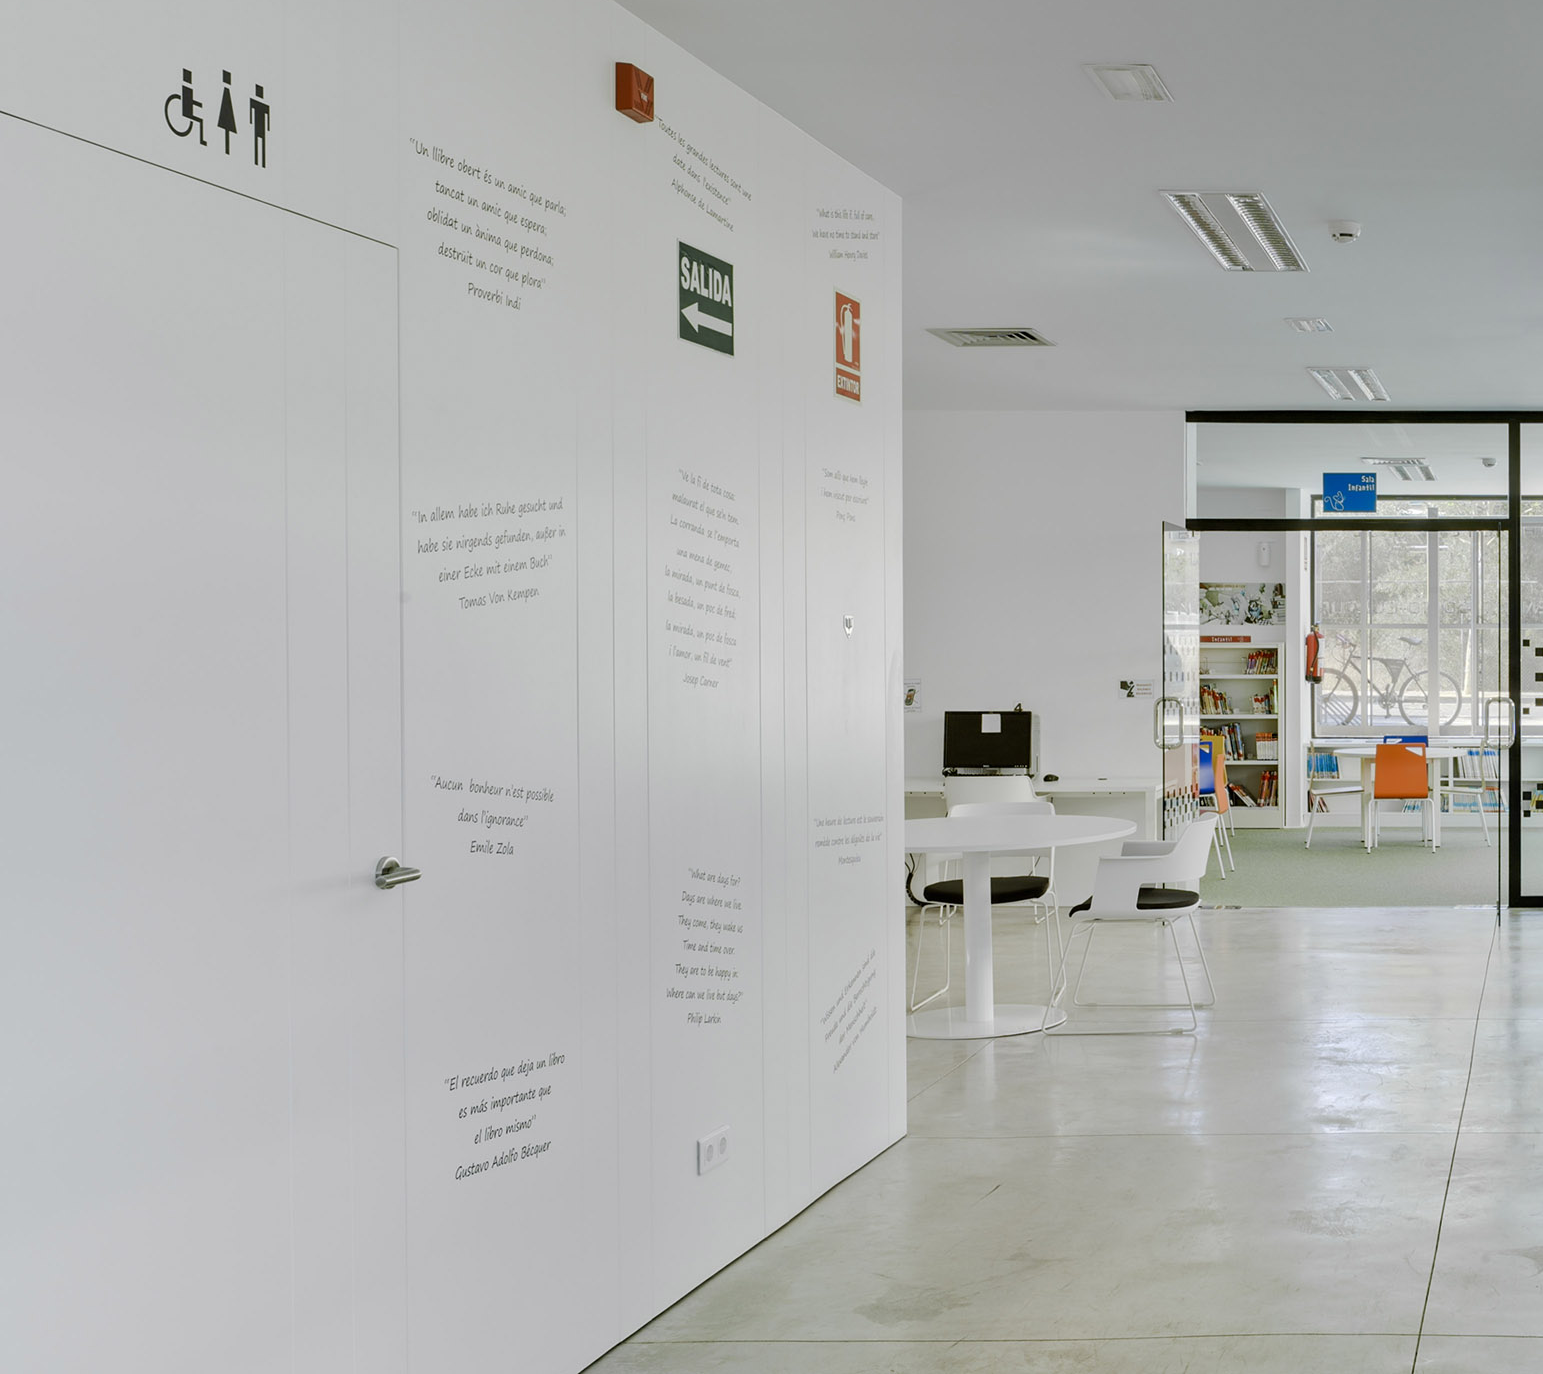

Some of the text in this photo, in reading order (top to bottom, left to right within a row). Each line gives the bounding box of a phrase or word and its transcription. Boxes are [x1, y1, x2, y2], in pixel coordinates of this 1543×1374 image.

[433, 147, 454, 168] llibre
[458, 159, 481, 179] obert
[484, 170, 492, 184] és
[495, 178, 505, 190] un
[508, 183, 527, 199] amic
[529, 191, 542, 206] que
[435, 180, 464, 202] tancat
[468, 195, 479, 208] un
[482, 200, 501, 217] amic
[504, 210, 518, 224] que
[427, 207, 458, 231] oblidat
[461, 222, 472, 235] un
[476, 224, 502, 246] ànima
[504, 239, 518, 254] que
[476, 258, 487, 270] un
[490, 263, 503, 275] cor
[505, 269, 519, 282] que
[681, 257, 732, 307] SALIDA
[468, 282, 521, 310] Proverbi Indi
[430, 507, 454, 522] allem
[458, 504, 478, 518] habe
[481, 503, 493, 517] ich
[496, 502, 515, 515] Ruhe
[518, 499, 546, 517] gesucht
[549, 497, 563, 510] und
[418, 525, 566, 554] habe sie nirgends gefunden, außer in
[439, 569, 461, 583] einer
[464, 564, 483, 579] Ecke
[487, 561, 501, 576] mit
[504, 559, 528, 573] einem
[459, 587, 540, 610] Tomas Von Kempen
[1013, 703, 1023, 712] 4
[469, 778, 503, 796] bonheur
[506, 785, 524, 799] n'est
[526, 788, 554, 803] possible
[458, 808, 478, 823] dans
[470, 840, 514, 855] Emile Zola
[707, 873, 716, 883] are
[717, 873, 729, 888] days
[682, 891, 695, 906] Days
[697, 896, 705, 905] are
[707, 896, 722, 907] where
[724, 900, 732, 908] we
[678, 915, 691, 930] They
[710, 919, 721, 933] they
[723, 922, 736, 933] wake
[683, 939, 696, 951] Time
[698, 942, 708, 952] and
[710, 942, 722, 954] time
[675, 963, 731, 981] They are to be happy
[666, 988, 684, 999] Where
[686, 990, 695, 999] can
[697, 991, 705, 1000] we
[706, 989, 715, 1000] live
[716, 990, 725, 1001] but
[688, 1012, 721, 1027] Philip Larkin
[461, 1067, 498, 1088] recuerdo
[501, 1066, 514, 1081] que
[518, 1059, 534, 1076] deja
[536, 1058, 546, 1069] un
[548, 1052, 565, 1066] libro
[458, 1085, 551, 1118] es más importante que
[474, 1129, 482, 1144] el
[485, 1125, 502, 1141] libro
[455, 1140, 551, 1180] Gustavo Adolfo Bécquer
